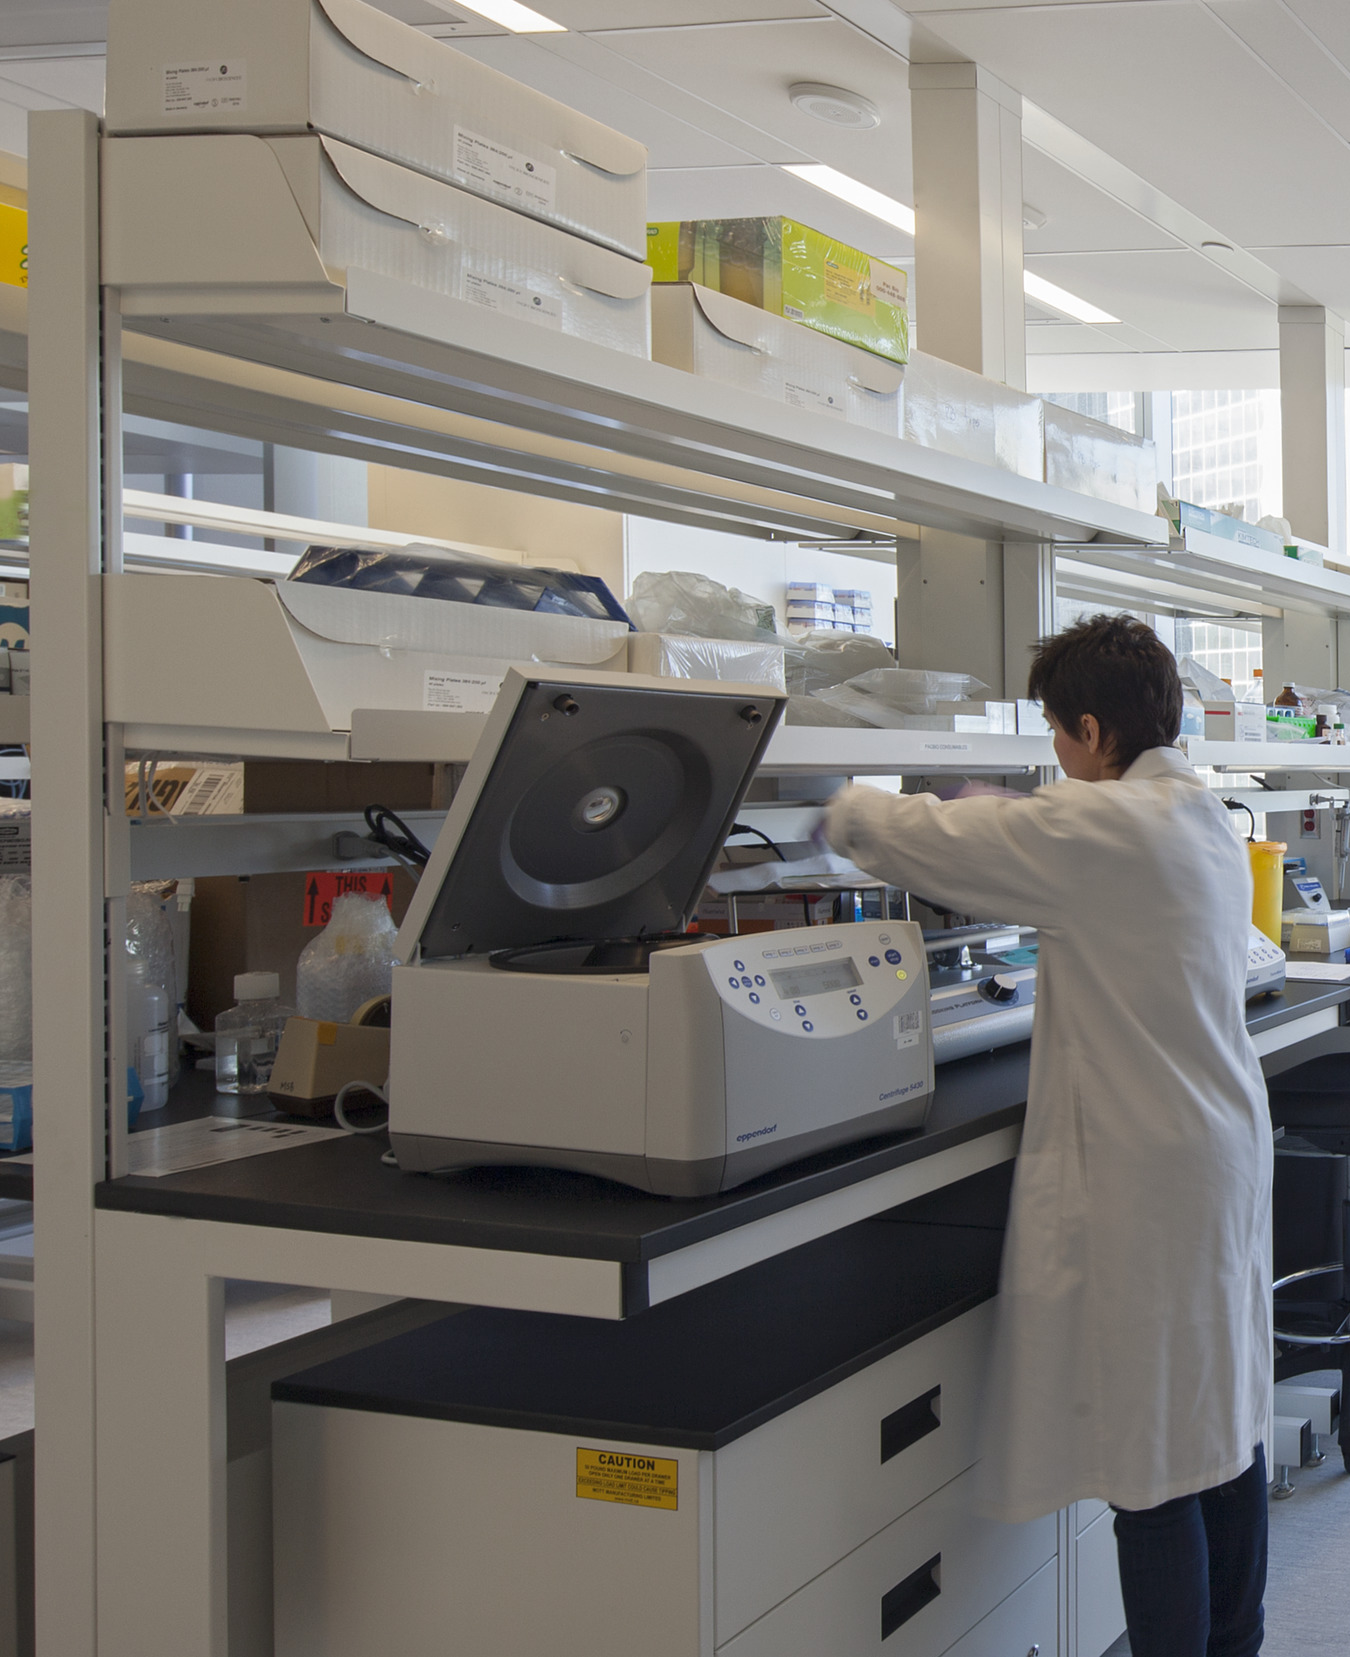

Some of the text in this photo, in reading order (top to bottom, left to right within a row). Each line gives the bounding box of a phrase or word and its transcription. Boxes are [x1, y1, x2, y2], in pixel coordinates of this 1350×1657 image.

[335, 875, 367, 897] THIS
[879, 1080, 924, 1101] Centrifuge 5430
[736, 1123, 778, 1143] eppendorf
[598, 1454, 656, 1471] CAUTION
